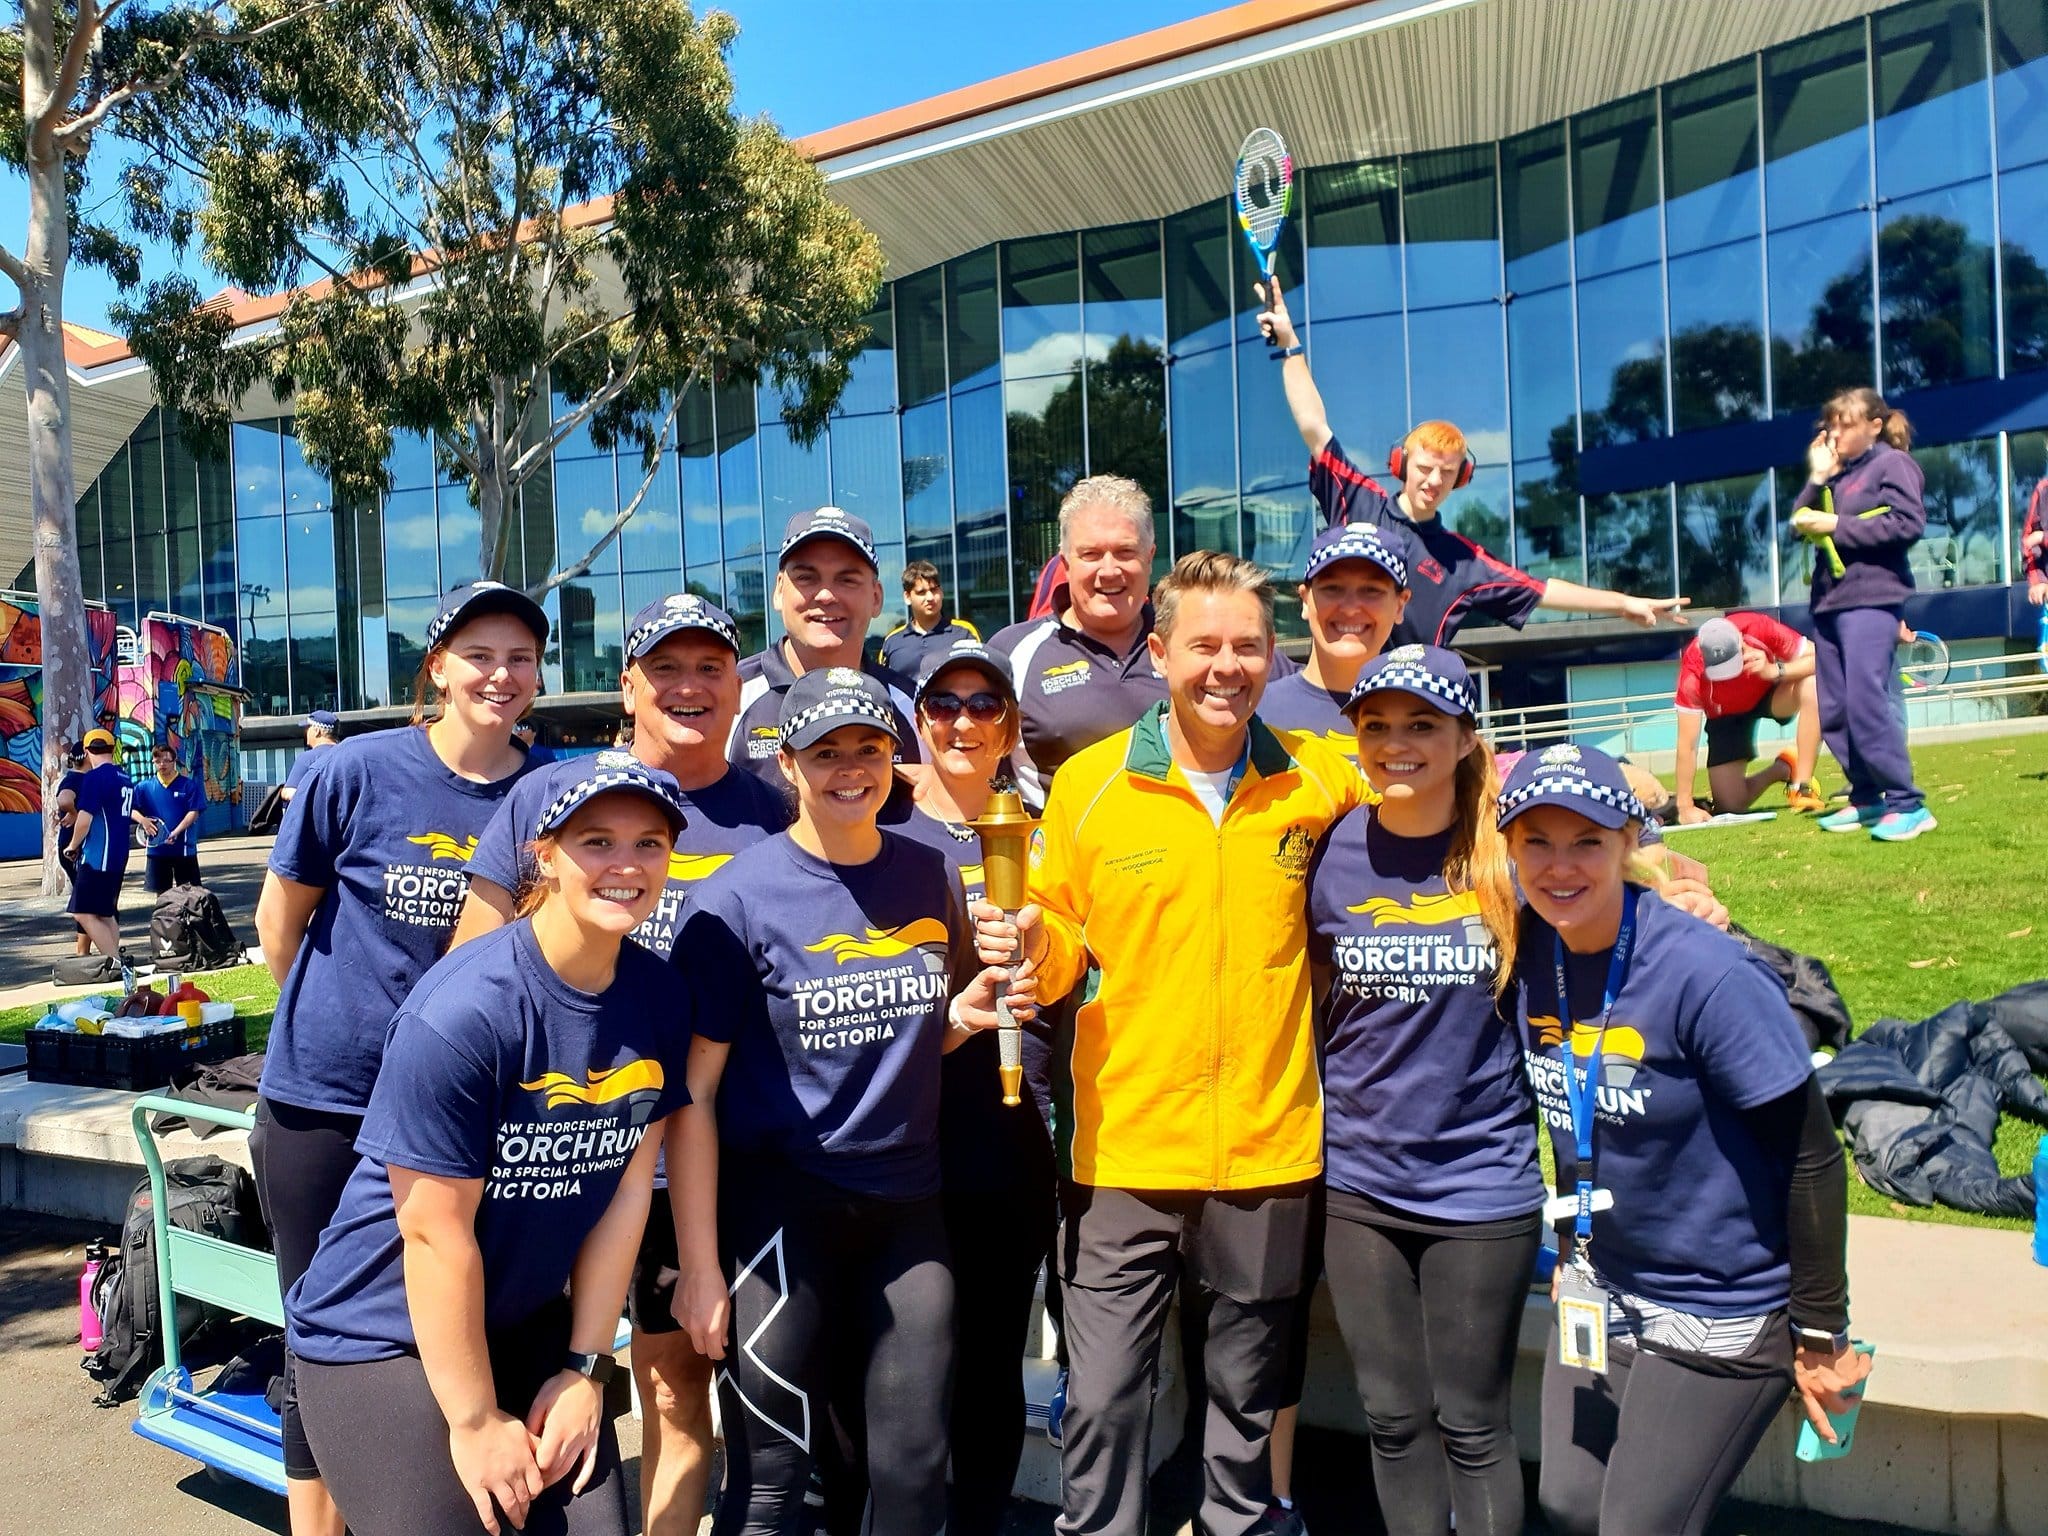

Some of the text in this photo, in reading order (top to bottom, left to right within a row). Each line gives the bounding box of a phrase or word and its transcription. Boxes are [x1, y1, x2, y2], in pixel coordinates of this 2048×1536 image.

[388, 864, 467, 880] LAW ENFORC
[385, 895, 460, 916] VICTORI
[385, 909, 406, 922] FOR
[408, 914, 450, 927] SPECIAL
[1357, 935, 1452, 948] ENFORCEMENT
[1335, 946, 1496, 972] TORCH RUN
[795, 965, 914, 992] LAW ENFORCEMENT
[1342, 972, 1477, 986] FOR SPECIAL OLYMPICS
[792, 973, 949, 1018] TORCH RUN
[1342, 984, 1431, 1004] VICTORIA
[800, 1002, 935, 1031] FOR SPECIAL OLYMPICS
[800, 1023, 896, 1050] VICTORIA
[1595, 1085, 1646, 1116] UN
[500, 1117, 620, 1135] AW ENFORCEMENT
[597, 1124, 649, 1157] RUN
[491, 1156, 626, 1179] OR SPECIAL OLYMPICS
[1580, 1188, 1590, 1217] STAFF
